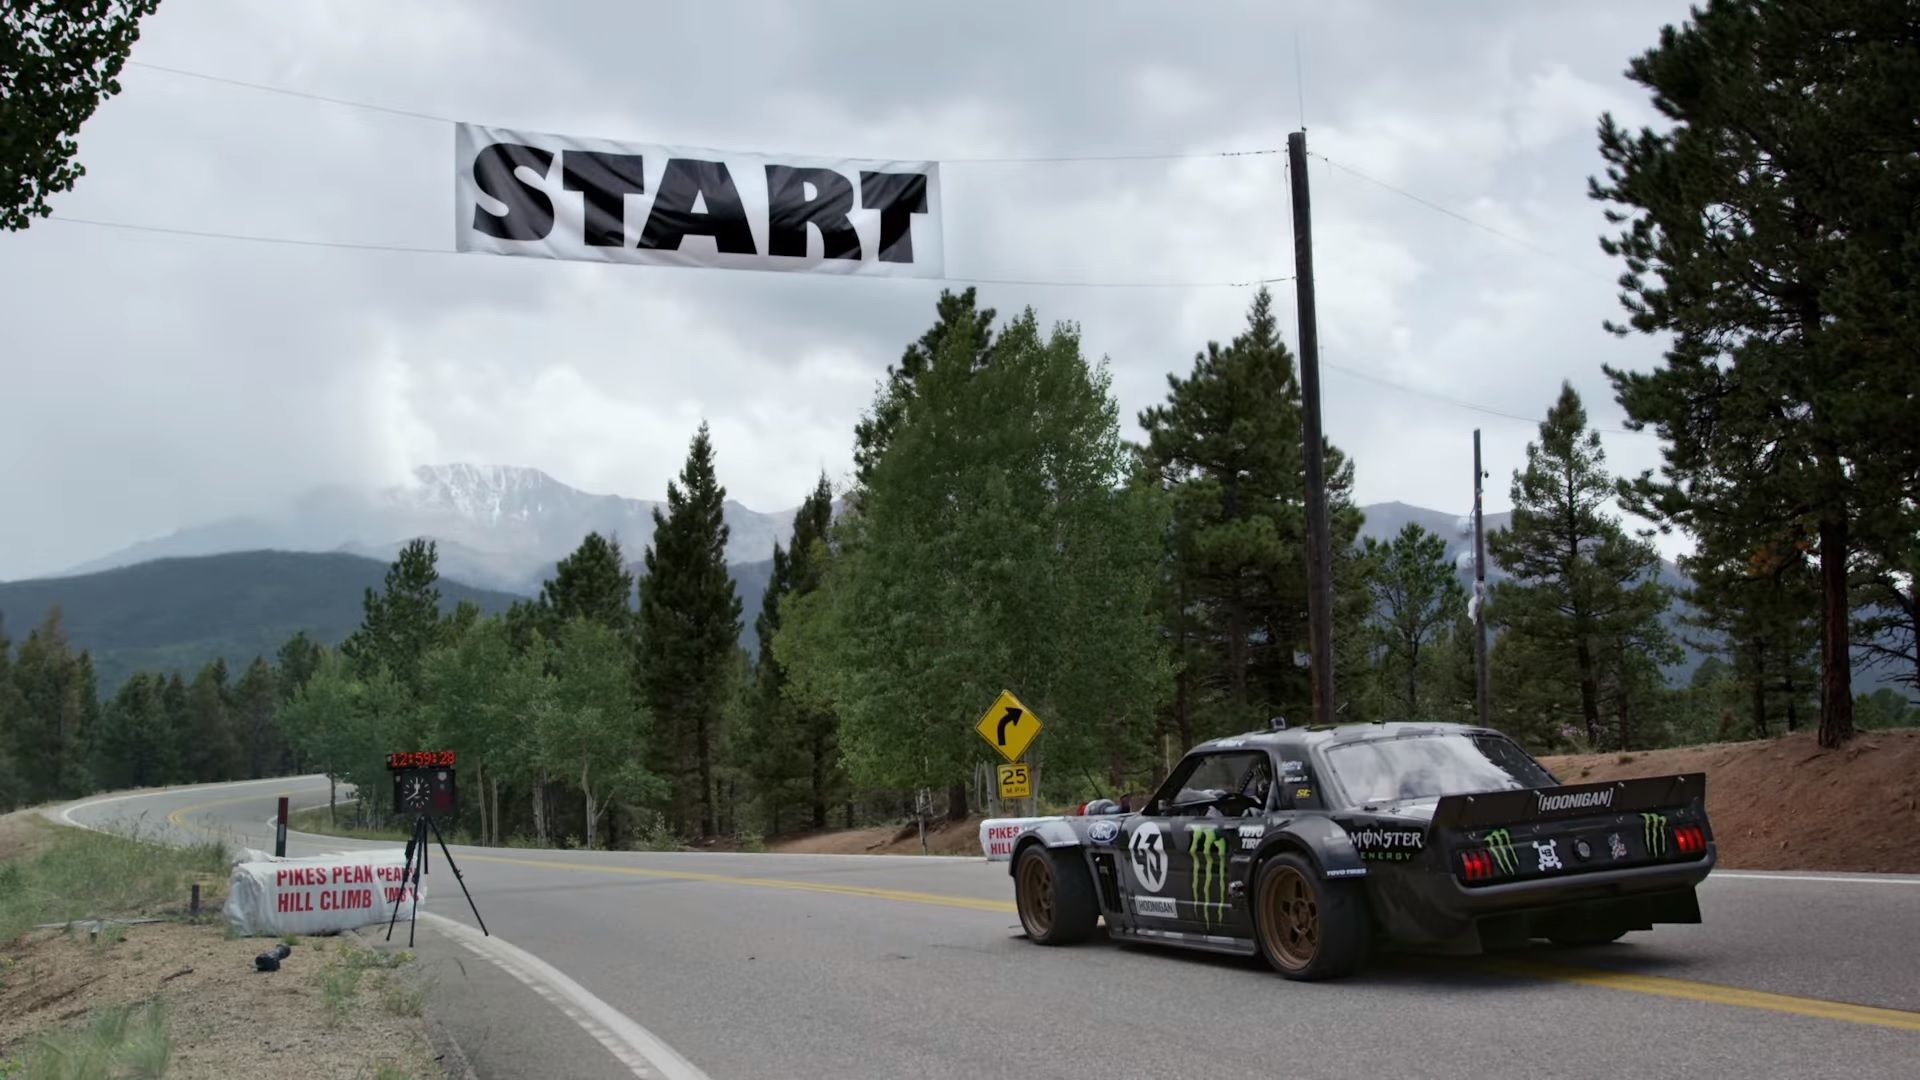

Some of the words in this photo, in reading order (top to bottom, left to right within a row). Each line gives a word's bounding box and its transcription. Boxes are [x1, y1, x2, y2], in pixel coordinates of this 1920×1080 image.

[473, 142, 929, 264] START
[391, 751, 455, 767] 12:59:28
[1001, 768, 1027, 785] 25
[1005, 786, 1026, 794] MPH
[1238, 824, 1265, 838] TOYO
[1349, 828, 1423, 850] MONSTER
[1133, 832, 1163, 886] 43
[1360, 851, 1412, 861] ENERGY
[276, 867, 327, 887] PIKES
[332, 864, 373, 885] PEAK
[277, 891, 314, 913] HILL
[319, 888, 372, 911] CLIMB
